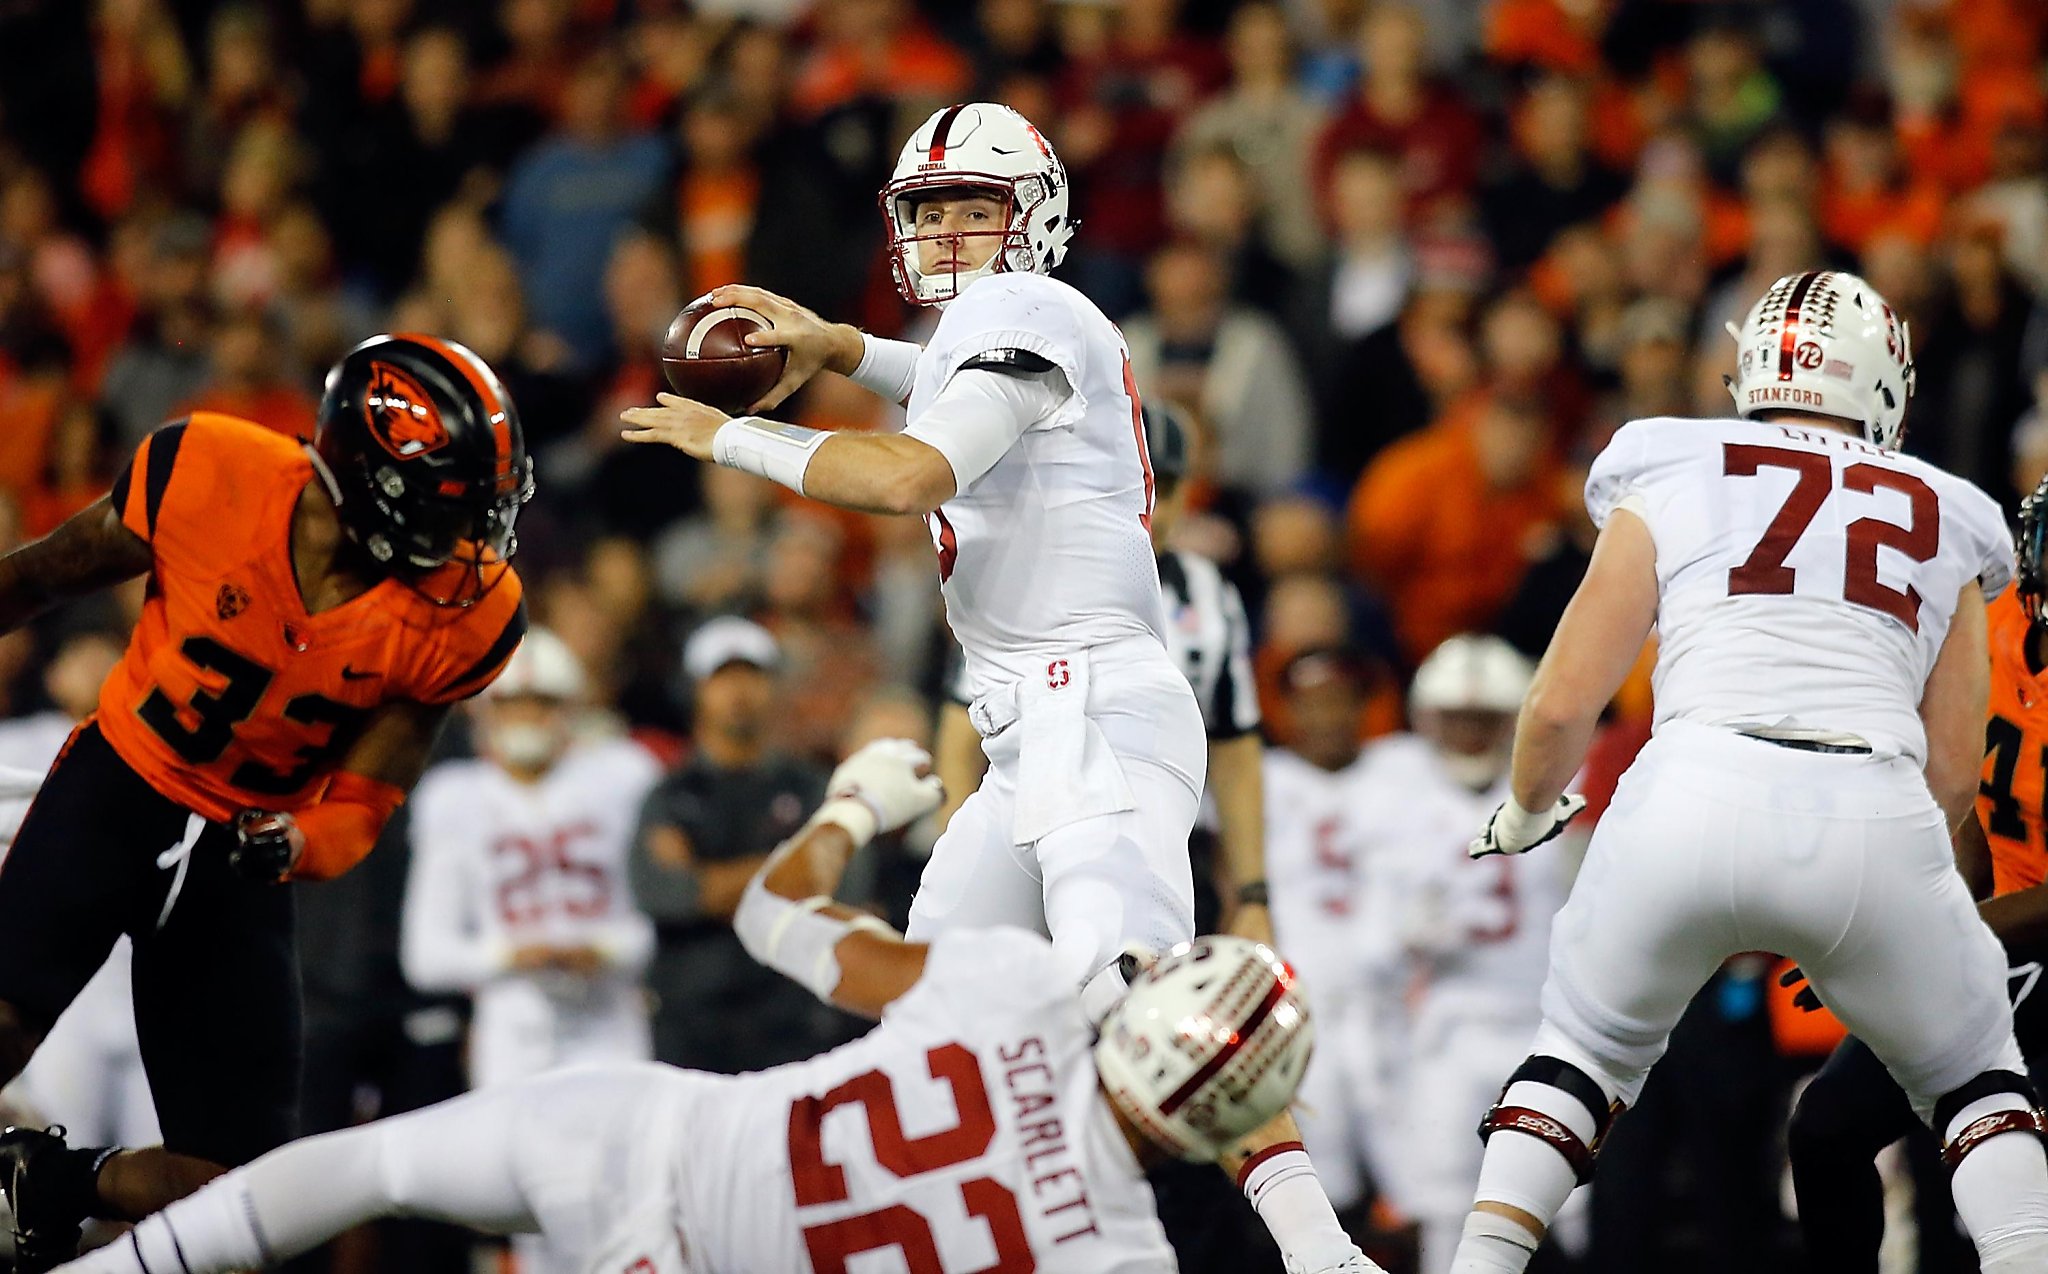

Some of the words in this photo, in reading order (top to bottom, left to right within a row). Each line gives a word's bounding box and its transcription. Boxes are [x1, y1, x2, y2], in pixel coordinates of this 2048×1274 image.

[1749, 386, 1823, 407] STANFORD
[1722, 442, 1940, 636] 72
[136, 635, 370, 795] 33
[1979, 713, 2048, 851] 4
[492, 822, 612, 922] 25
[1000, 1038, 1099, 1244] SCARLETT
